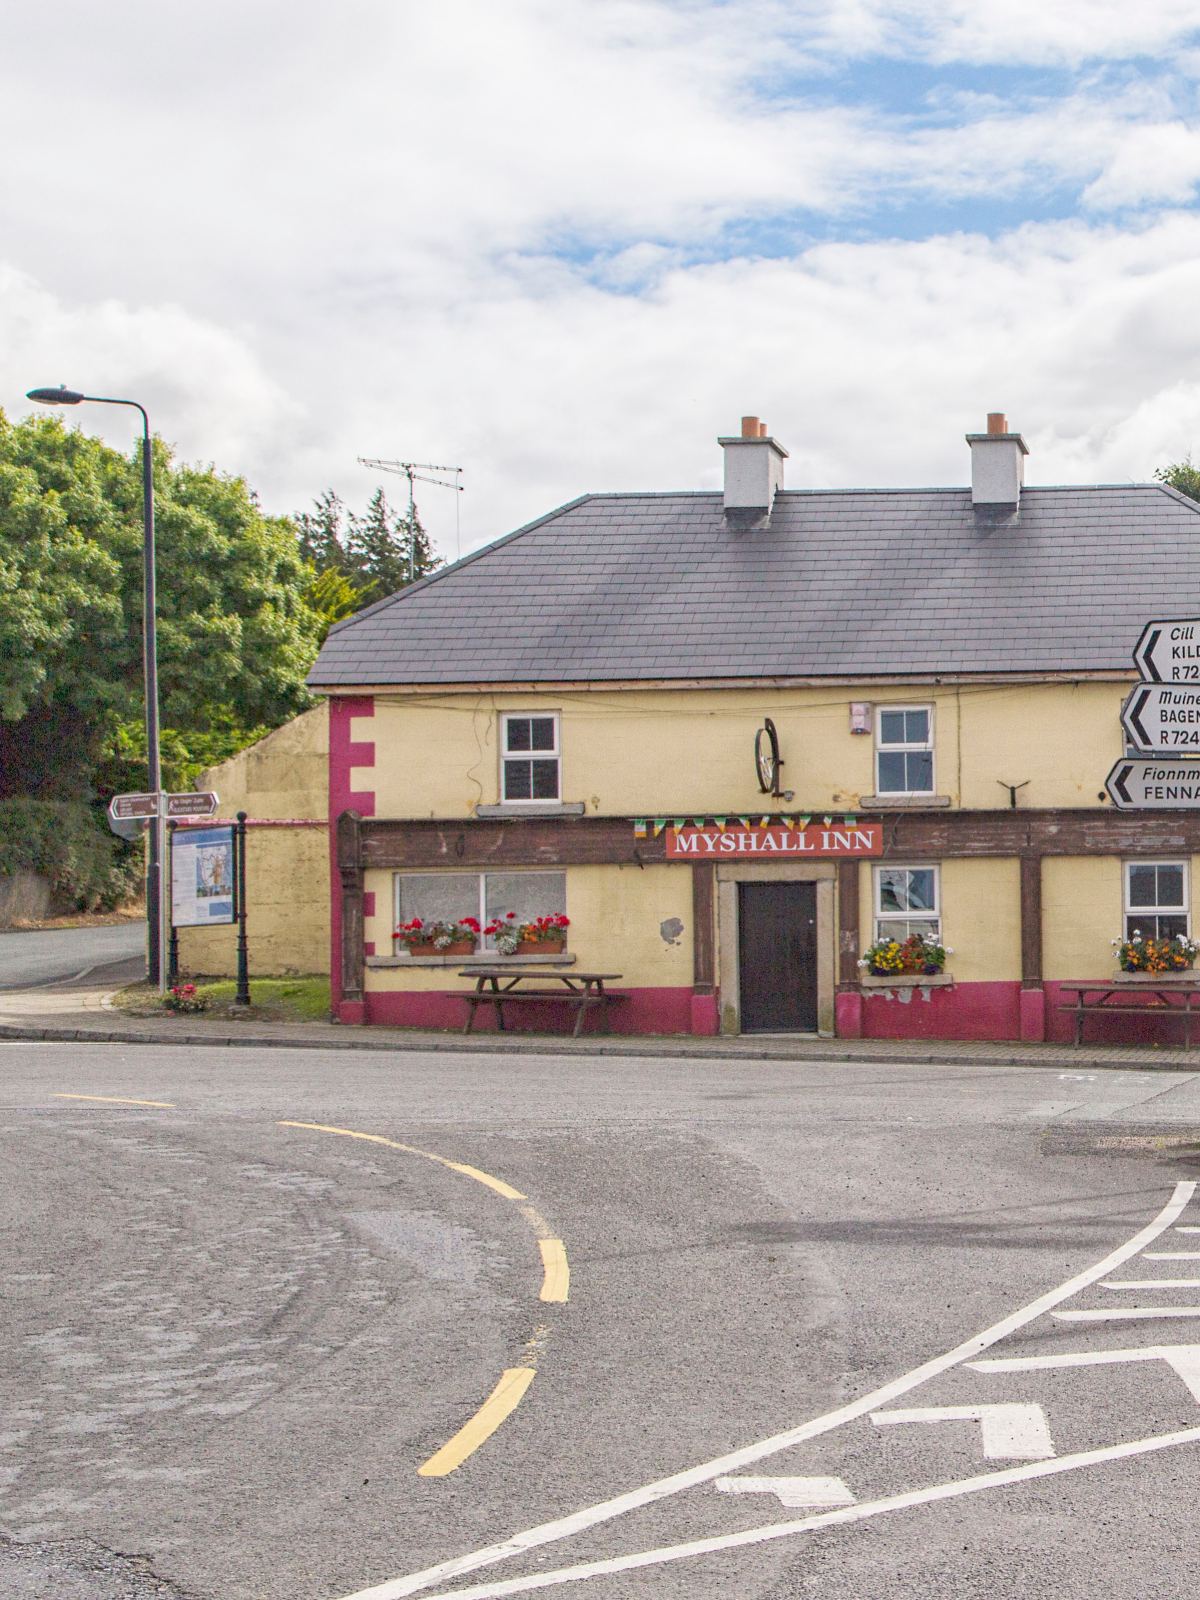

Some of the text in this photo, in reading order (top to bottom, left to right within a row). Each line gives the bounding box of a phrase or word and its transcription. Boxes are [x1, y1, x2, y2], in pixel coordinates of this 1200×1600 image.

[1170, 626, 1194, 641] Cill
[674, 831, 875, 853] MYSHALL INN
